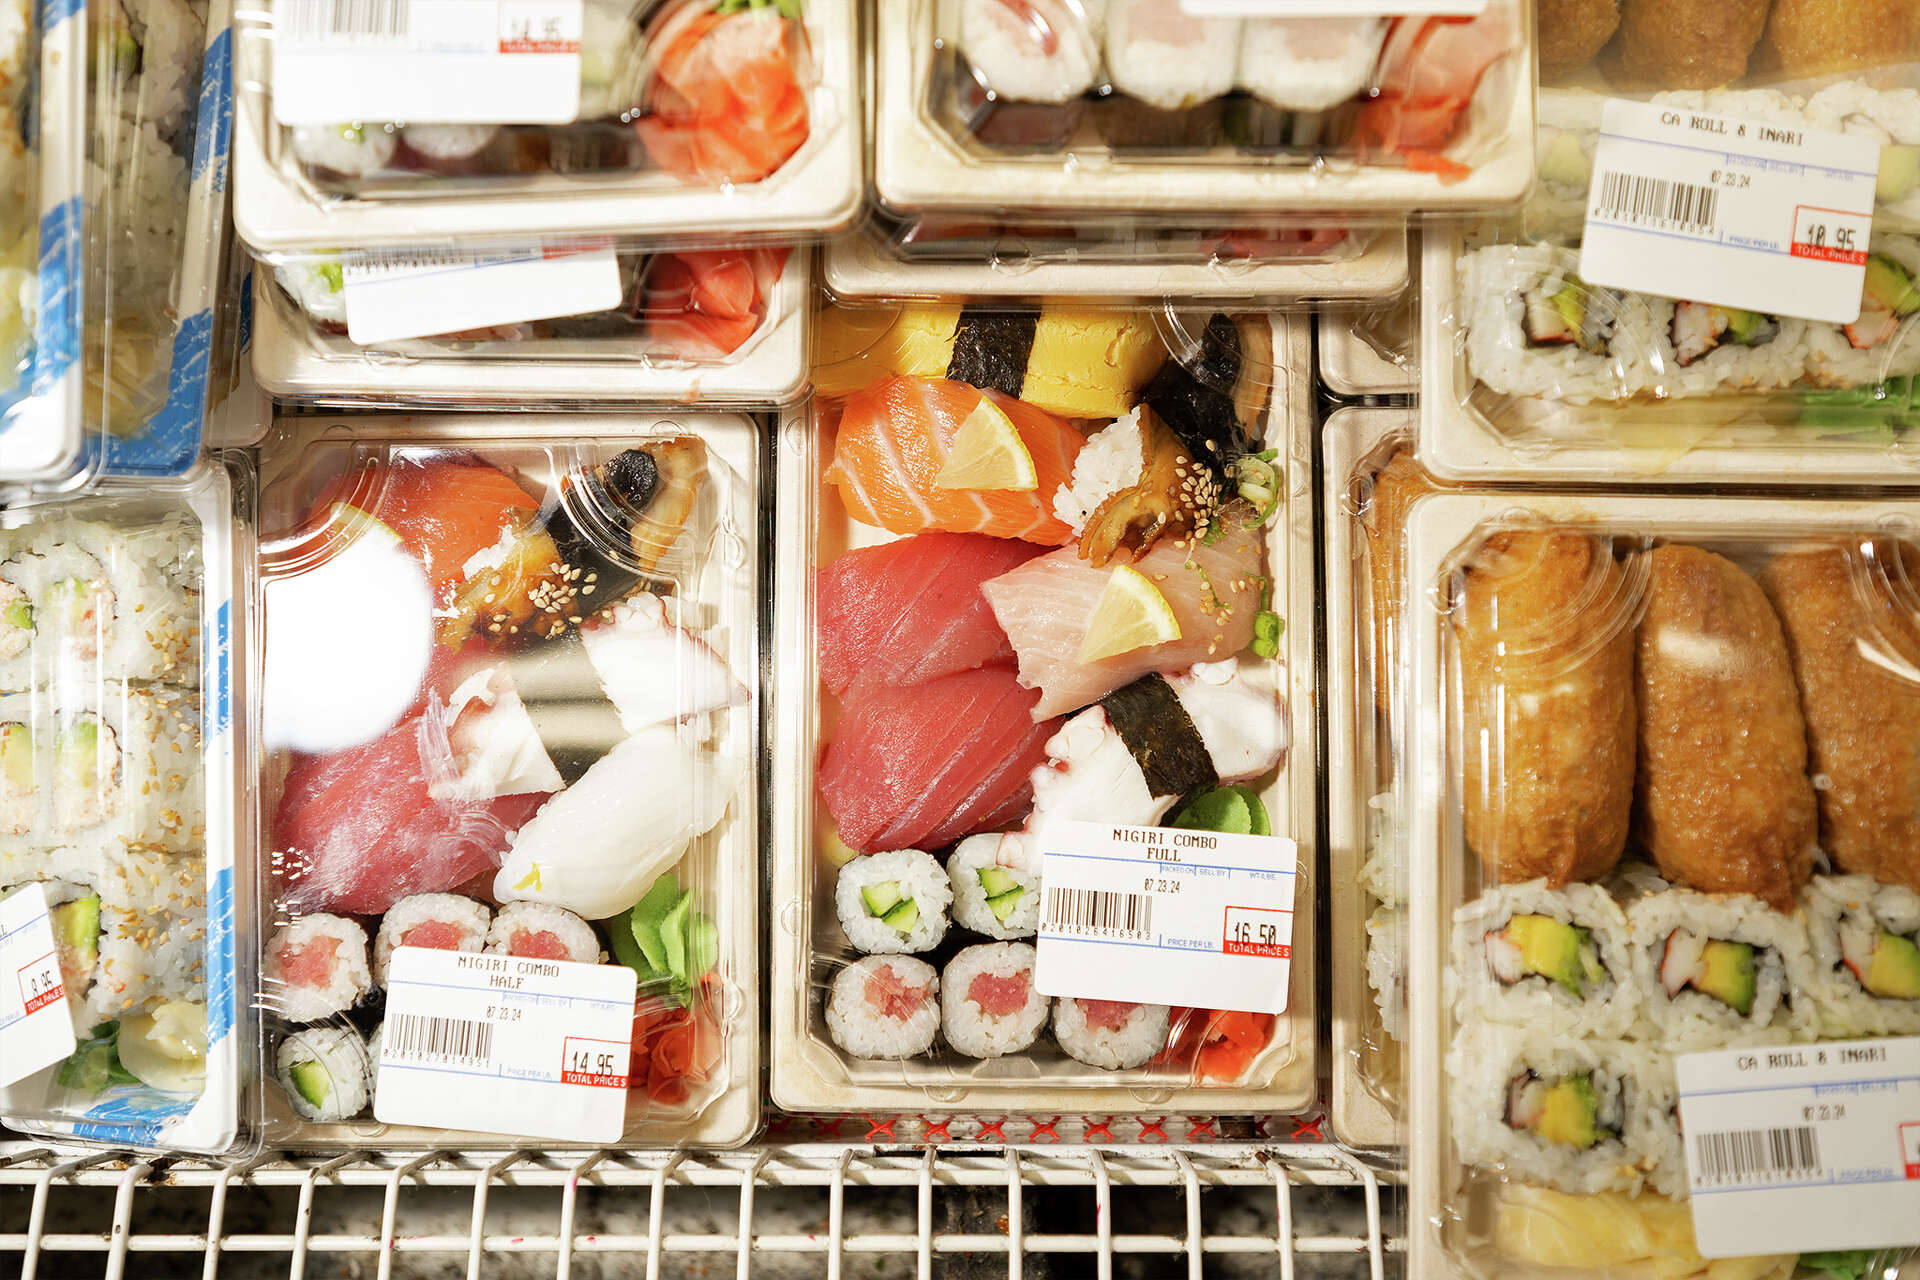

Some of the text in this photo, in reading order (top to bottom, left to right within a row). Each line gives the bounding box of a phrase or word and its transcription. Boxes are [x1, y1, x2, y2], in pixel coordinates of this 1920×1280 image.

[1661, 111, 1804, 147] CA ROLL & INARI
[1796, 245, 1826, 259] TOTAL
[1828, 249, 1857, 263] PRICE
[1112, 828, 1218, 850] NIGIRI COMBO
[1146, 846, 1182, 862] FULL
[1167, 937, 1187, 948] PRICE
[1188, 939, 1205, 950] PER
[1228, 942, 1255, 954] TOTAL
[1256, 946, 1282, 957] PRICE
[457, 955, 560, 978] NIGIRI COMBO
[489, 974, 525, 990] HALF
[1737, 1054, 1759, 1071] CA
[1768, 1051, 1809, 1069] ROLL
[1840, 1047, 1887, 1066] INARI
[566, 1072, 592, 1085] TOTAL
[593, 1075, 619, 1087] PRICE
